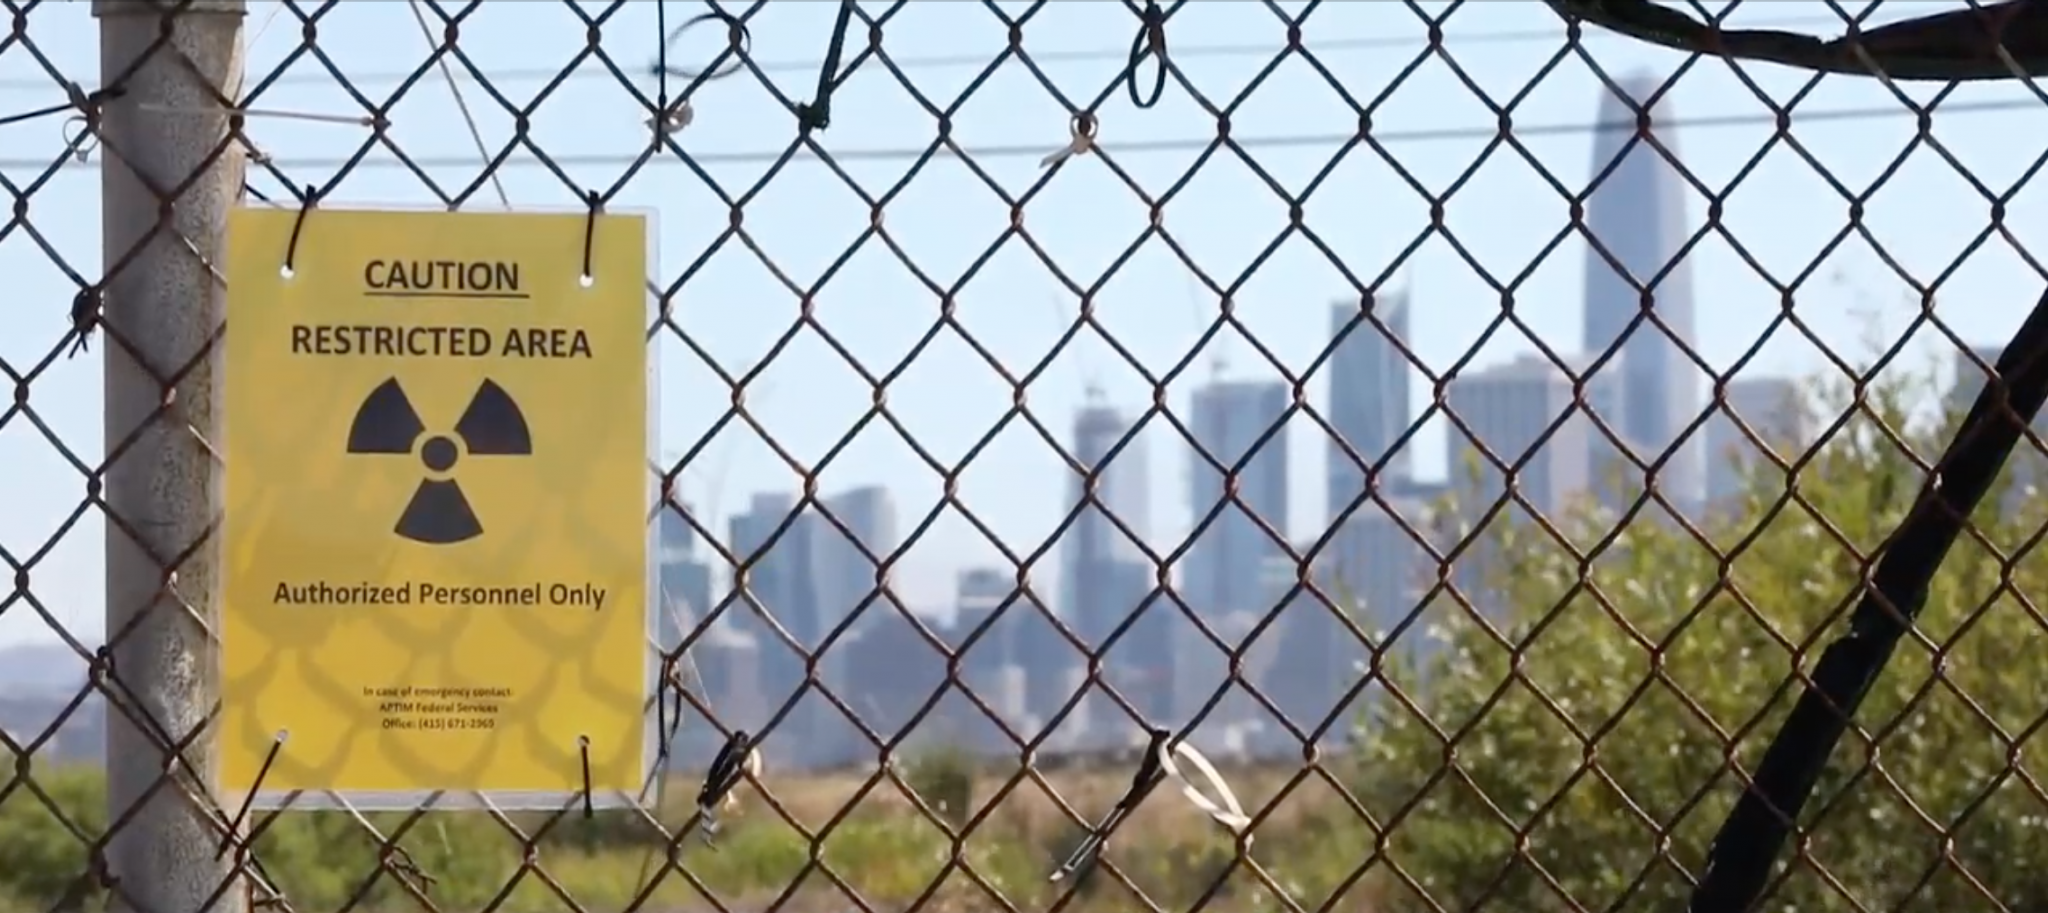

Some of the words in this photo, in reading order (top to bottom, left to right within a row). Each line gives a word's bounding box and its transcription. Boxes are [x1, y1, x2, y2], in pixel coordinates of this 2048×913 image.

[363, 260, 520, 291] CAUTION
[291, 325, 492, 357] RESTRICTED
[502, 328, 593, 359] AREA
[273, 580, 411, 606] Authorized
[418, 582, 543, 607] Personnel
[549, 584, 606, 611] Only
[363, 686, 374, 697] In
[376, 687, 398, 698] case
[400, 686, 412, 698] of
[414, 688, 470, 700] emergency
[416, 702, 455, 714] Federal
[456, 703, 499, 714] Services
[418, 718, 446, 731] (415)
